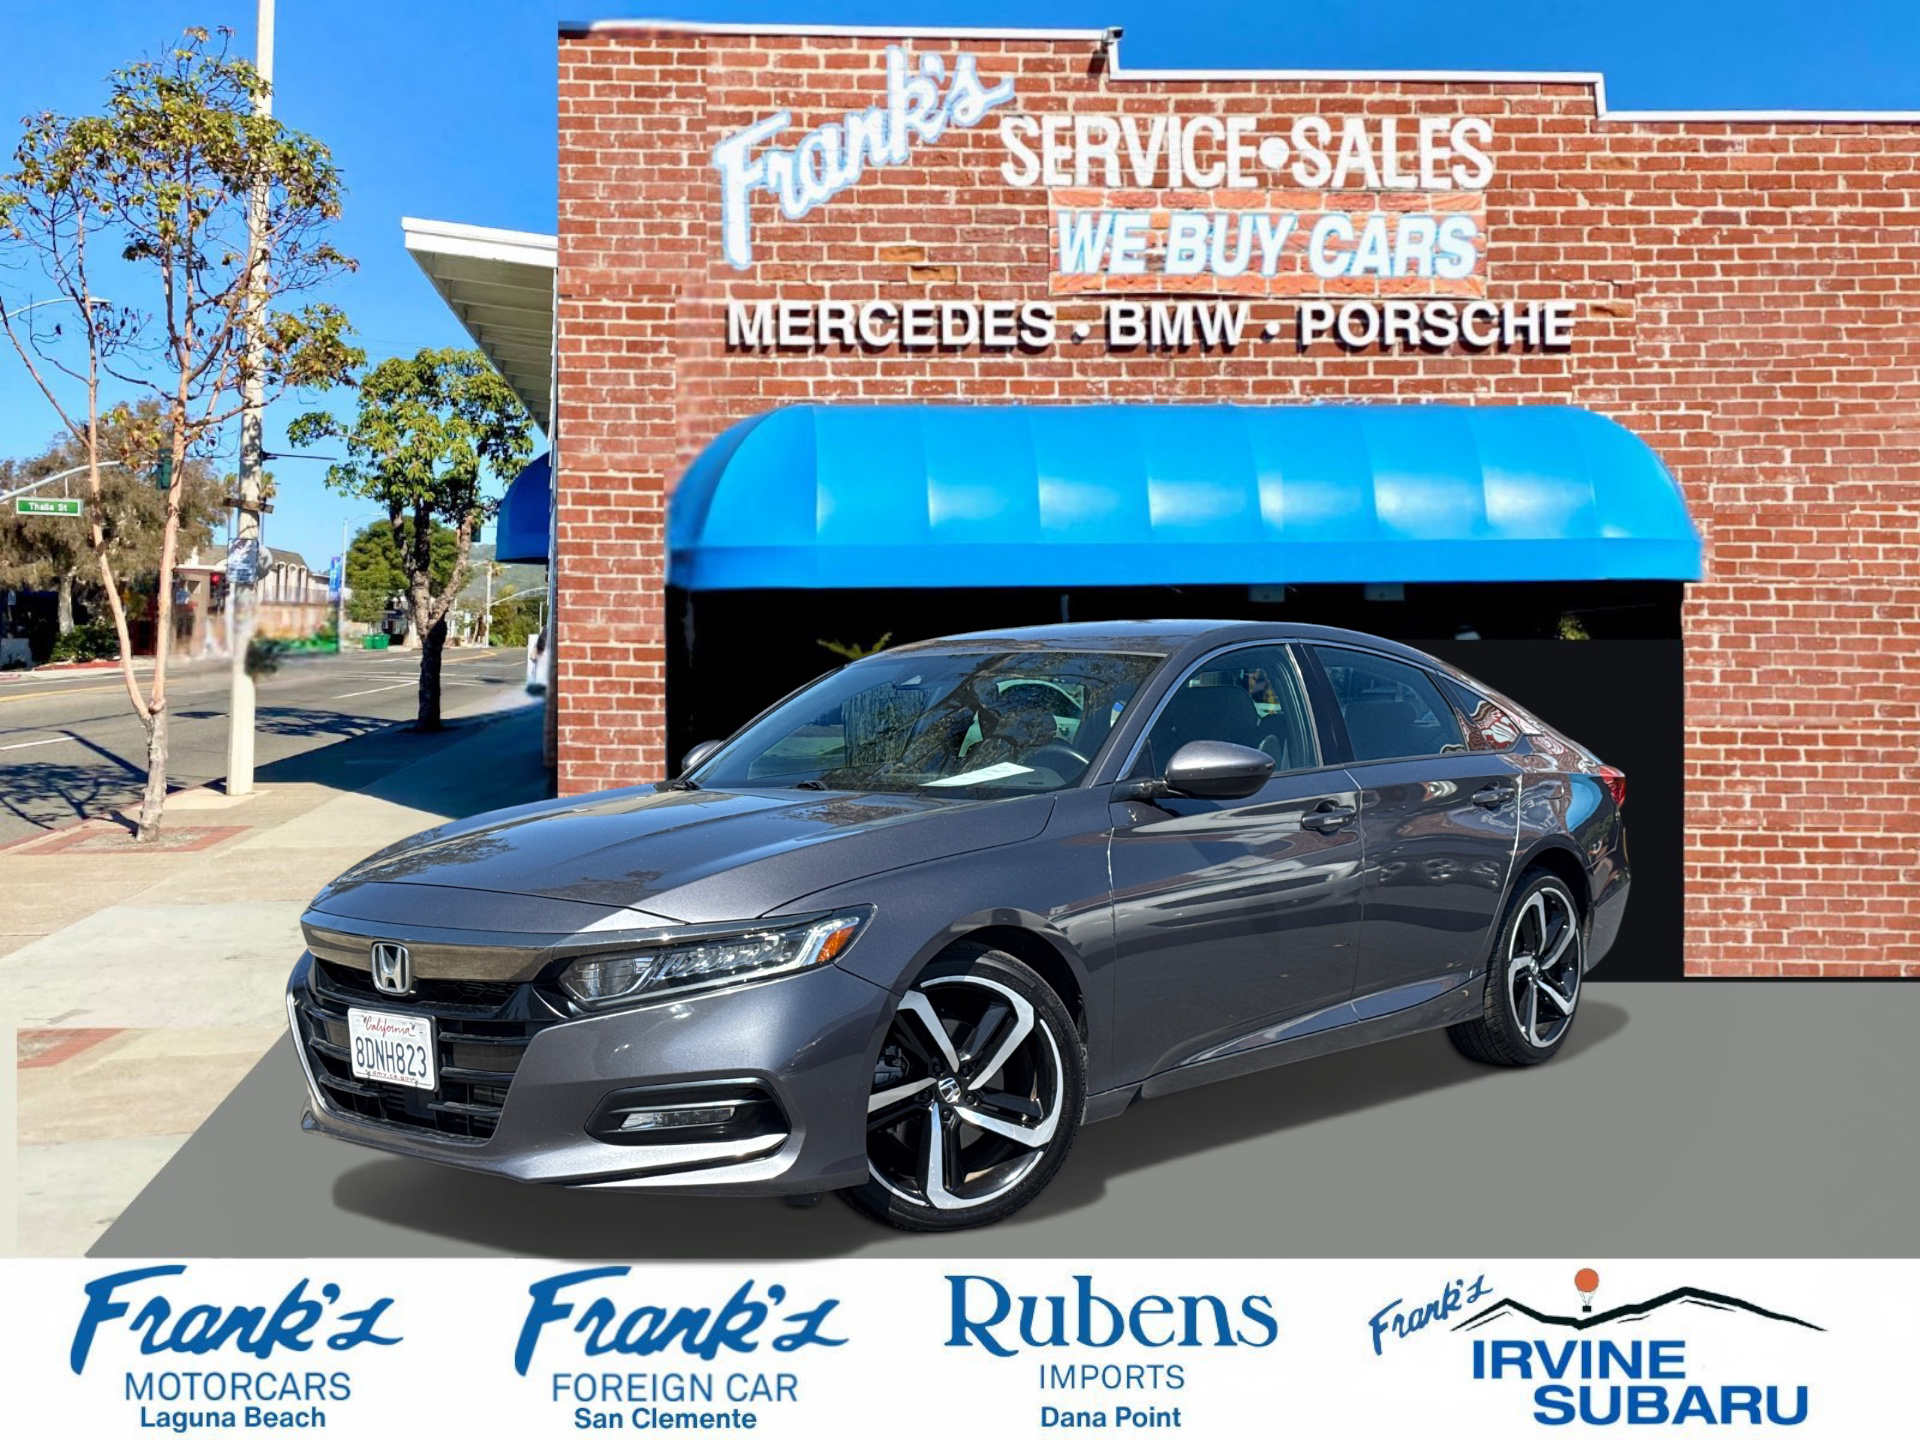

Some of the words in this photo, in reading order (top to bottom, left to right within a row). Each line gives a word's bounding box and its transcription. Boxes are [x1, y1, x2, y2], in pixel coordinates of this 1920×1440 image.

[712, 44, 1015, 270] Frank's
[1056, 210, 1153, 275] WE
[1163, 210, 1297, 276] BUY
[1307, 214, 1480, 279] CARS
[727, 300, 1056, 349] MERCEDES
[1107, 301, 1248, 348] BMW
[1299, 300, 1577, 350] PORSCHE
[365, 1015, 416, 1038] California
[355, 1036, 427, 1078] 8DNH823
